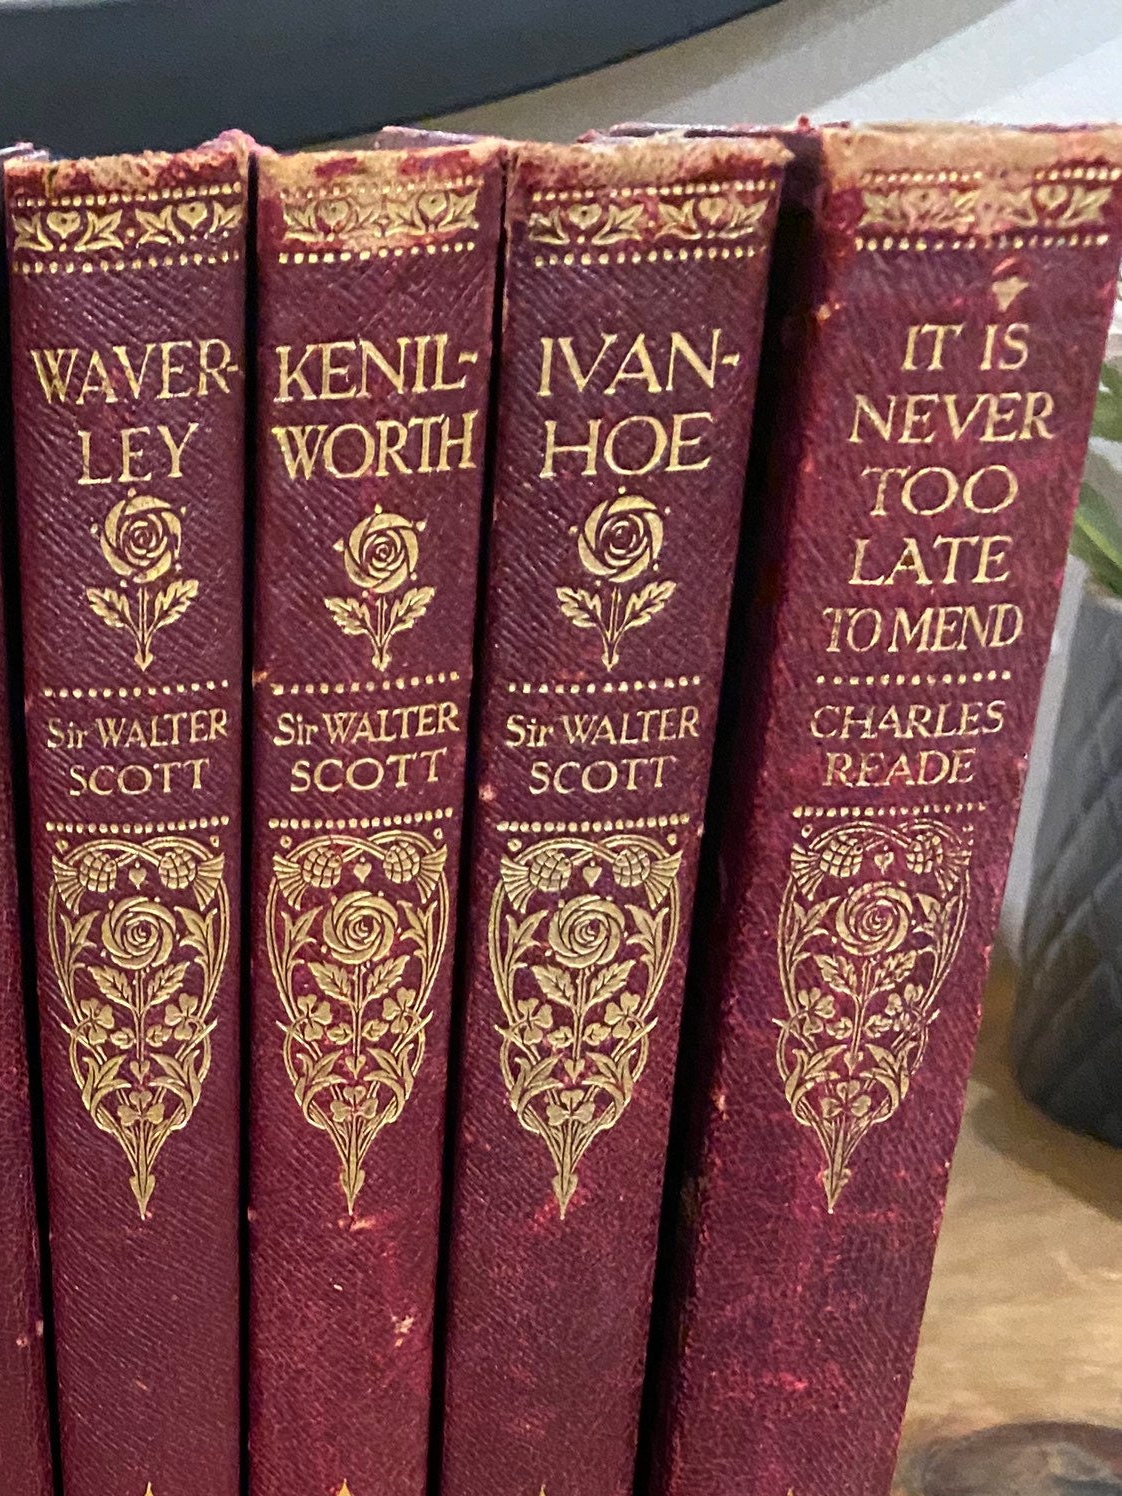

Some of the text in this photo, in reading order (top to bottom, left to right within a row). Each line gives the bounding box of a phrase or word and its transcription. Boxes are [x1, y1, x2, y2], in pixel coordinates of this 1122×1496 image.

[901, 322, 1031, 371] IT IS
[848, 391, 1056, 444] NEVER
[77, 422, 199, 486] LEY
[271, 409, 479, 481] WORTH
[539, 411, 714, 479] HOE
[861, 464, 1019, 517] TOO
[848, 535, 1013, 586] LATE
[822, 603, 1024, 653] TO MEND
[47, 708, 229, 749] Sir WALTER
[274, 702, 460, 746] Sir WALTER
[506, 705, 700, 748] Sir WALTER
[809, 700, 1006, 740] CHARLES
[69, 758, 210, 797] SCOTT
[289, 748, 447, 793] SCOTT
[529, 755, 678, 795] SCOTT
[822, 748, 976, 787] READE
